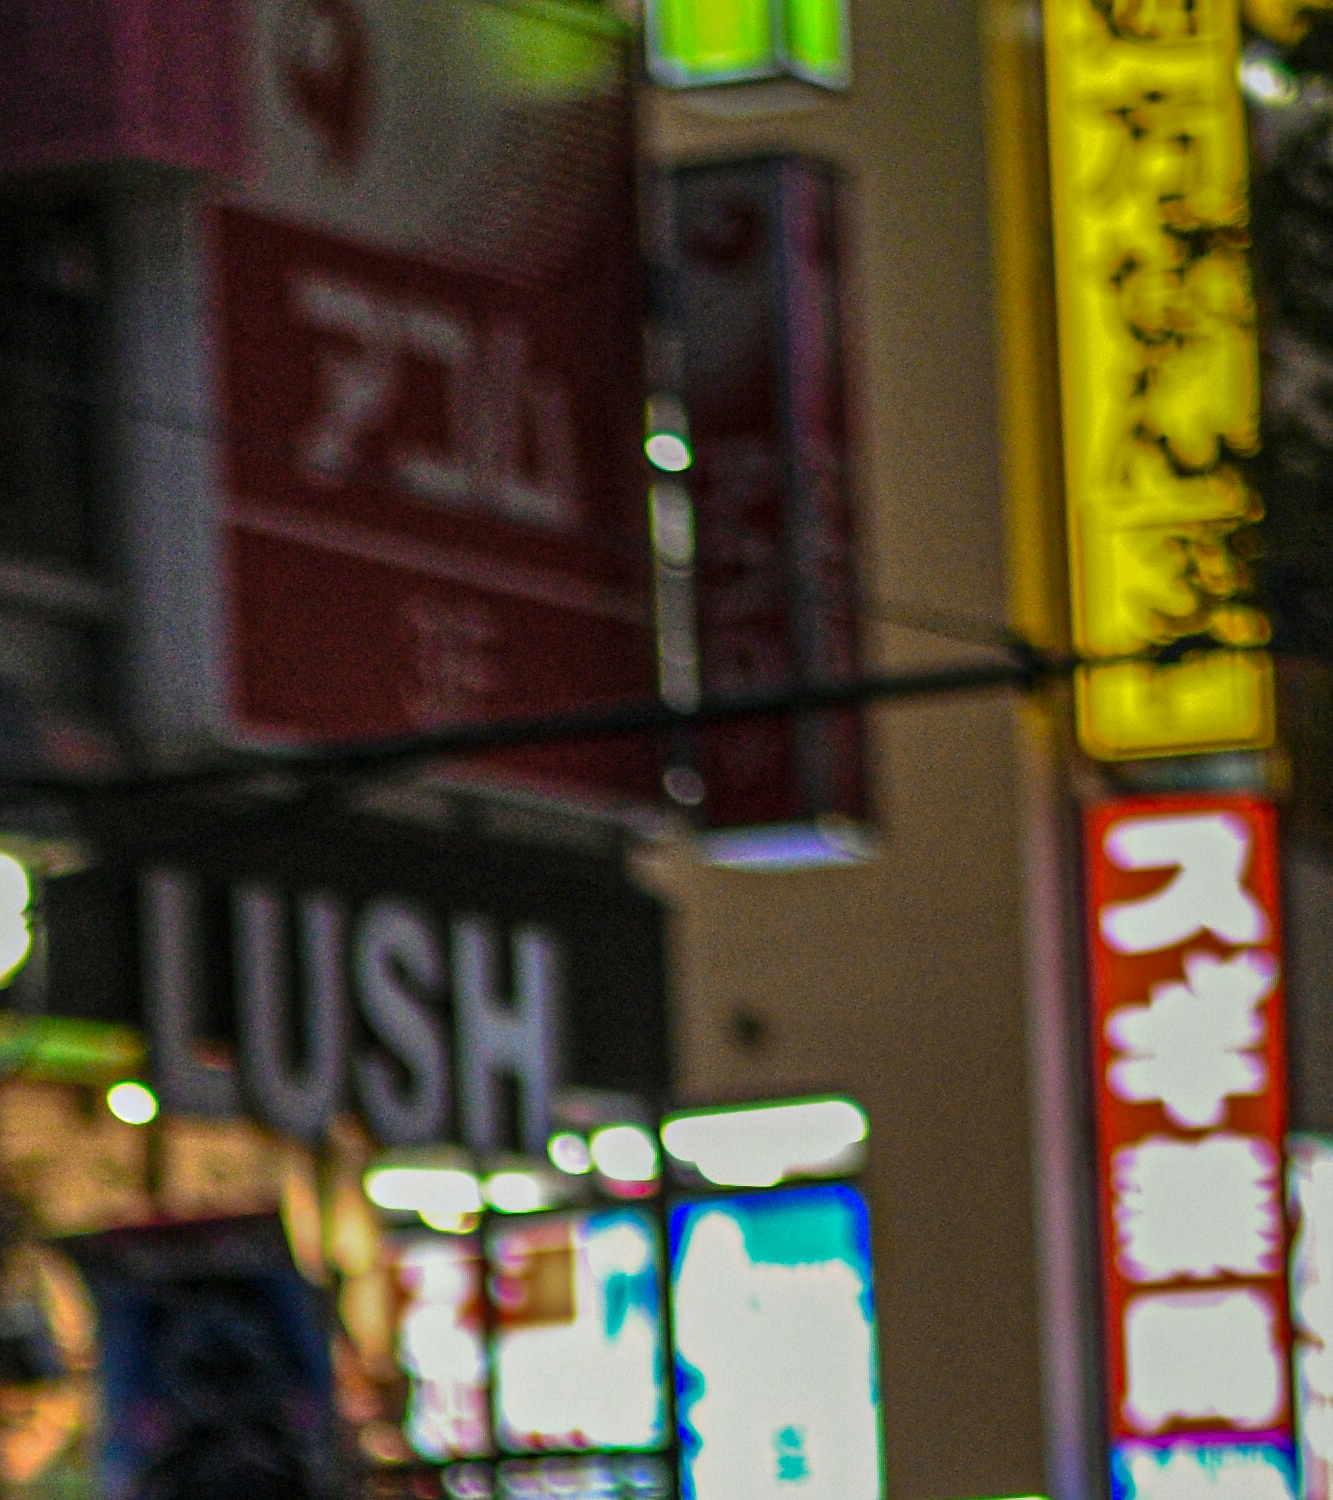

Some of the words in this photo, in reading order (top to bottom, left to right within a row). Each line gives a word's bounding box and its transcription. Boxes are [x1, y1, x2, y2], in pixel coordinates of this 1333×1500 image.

[288, 270, 583, 530] アコム
[147, 872, 567, 1158] LUSH
[1099, 810, 1281, 1430] スギ
